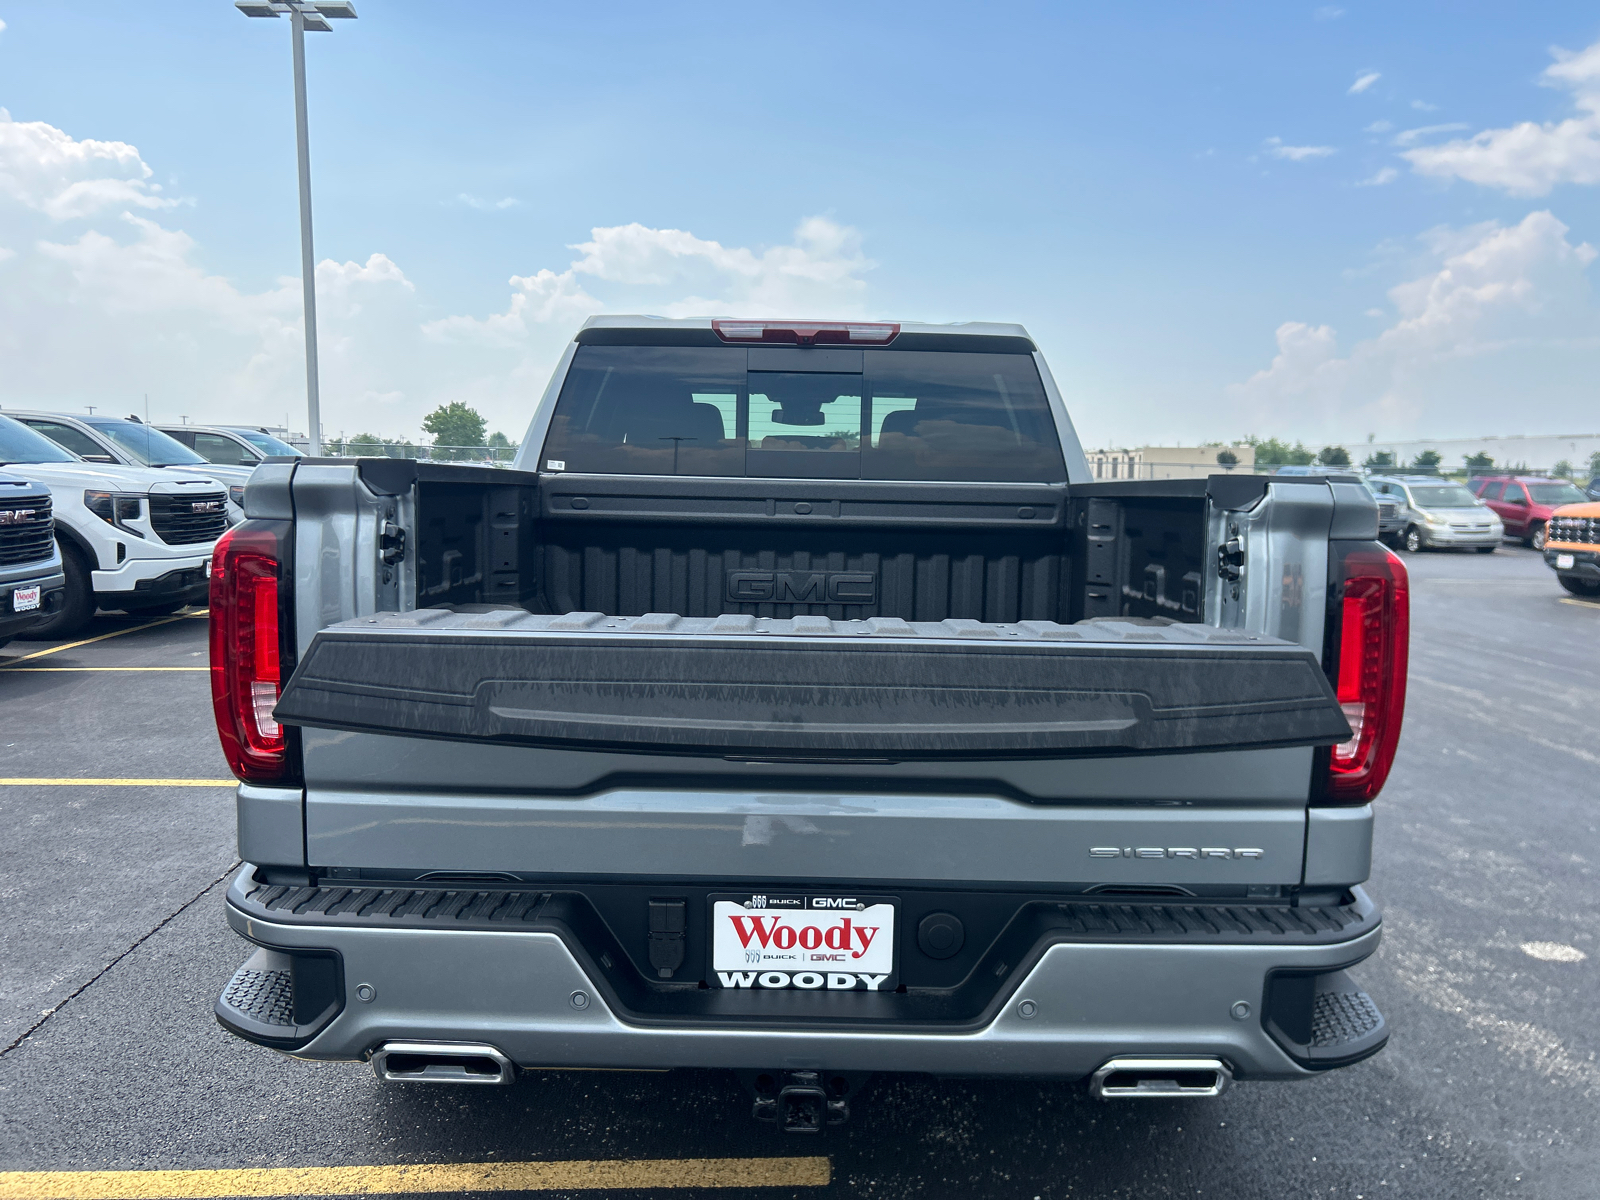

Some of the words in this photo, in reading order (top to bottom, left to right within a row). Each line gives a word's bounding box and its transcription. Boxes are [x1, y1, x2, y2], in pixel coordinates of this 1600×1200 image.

[729, 573, 873, 601] GMC
[1089, 847, 1265, 859] SIERRA
[812, 897, 857, 908] GMC
[728, 915, 880, 959] Woody
[810, 953, 846, 962] GMC
[717, 971, 889, 991] WOODY
